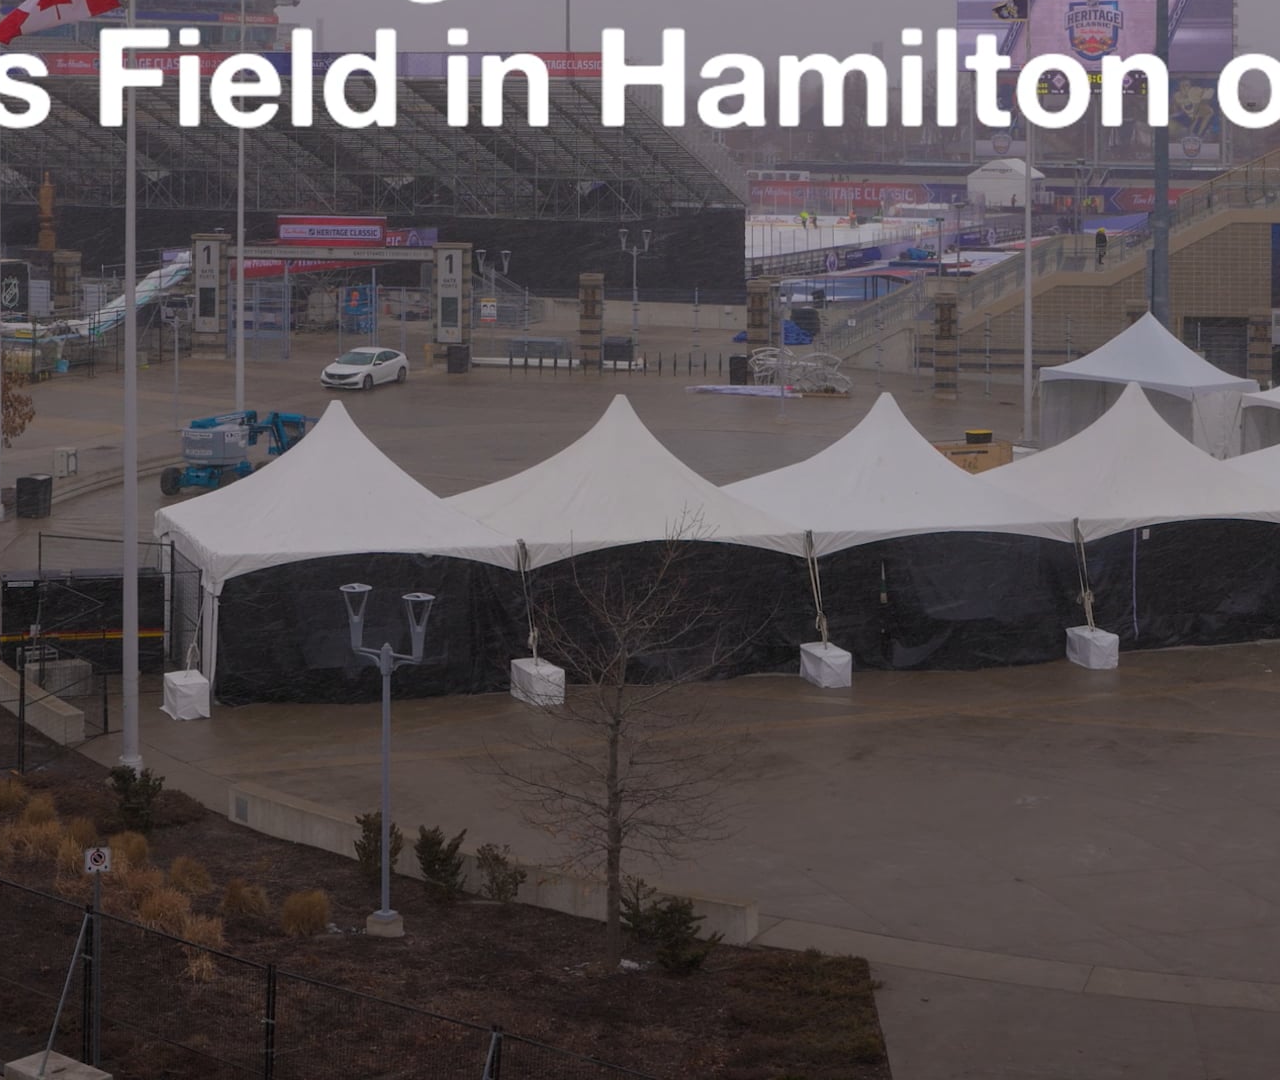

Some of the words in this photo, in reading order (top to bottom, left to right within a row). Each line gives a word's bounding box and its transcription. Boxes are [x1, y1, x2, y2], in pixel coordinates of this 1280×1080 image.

[1067, 9, 1121, 25] HERITAGE
[316, 228, 349, 237] HERITAGE
[349, 229, 378, 237] CLASSIC
[203, 245, 211, 264] 1
[445, 254, 454, 273] 1
